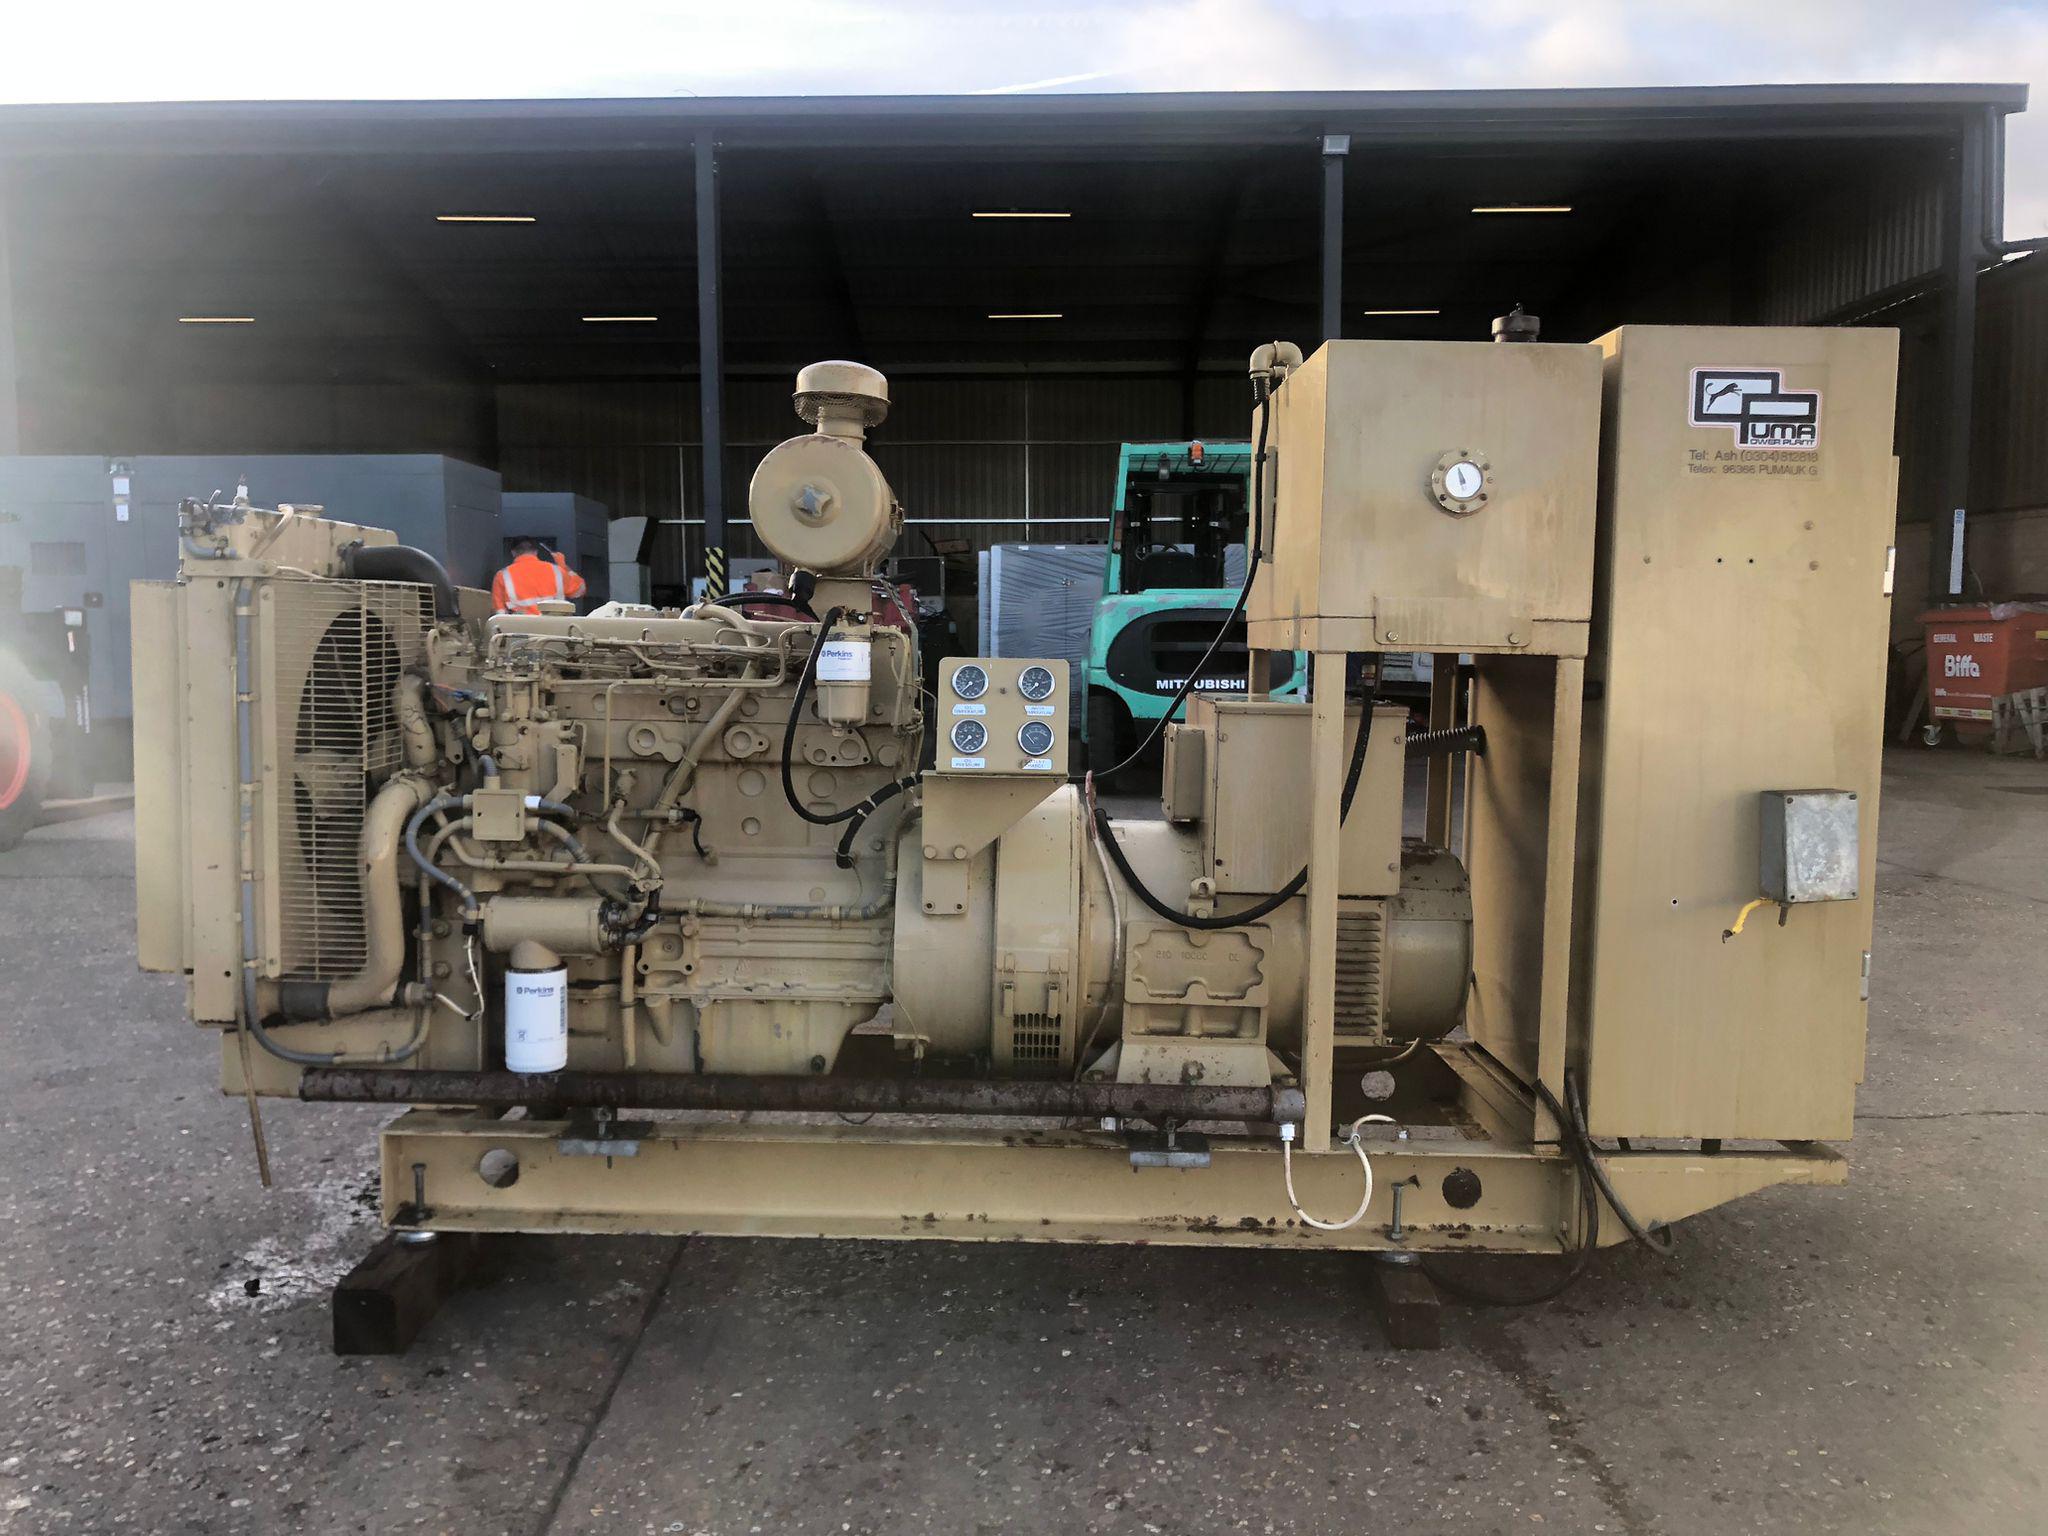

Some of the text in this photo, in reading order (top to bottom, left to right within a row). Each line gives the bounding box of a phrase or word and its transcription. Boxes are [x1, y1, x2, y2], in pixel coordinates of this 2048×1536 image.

[1689, 449, 1709, 461] Tel:
[1715, 450, 1737, 461] Ash
[1973, 633, 1994, 643] WASTE
[827, 650, 853, 658] Perkins
[1945, 654, 1980, 677] Biffa
[1156, 679, 1246, 690] MITUBISHI
[524, 986, 554, 995] Perkins
